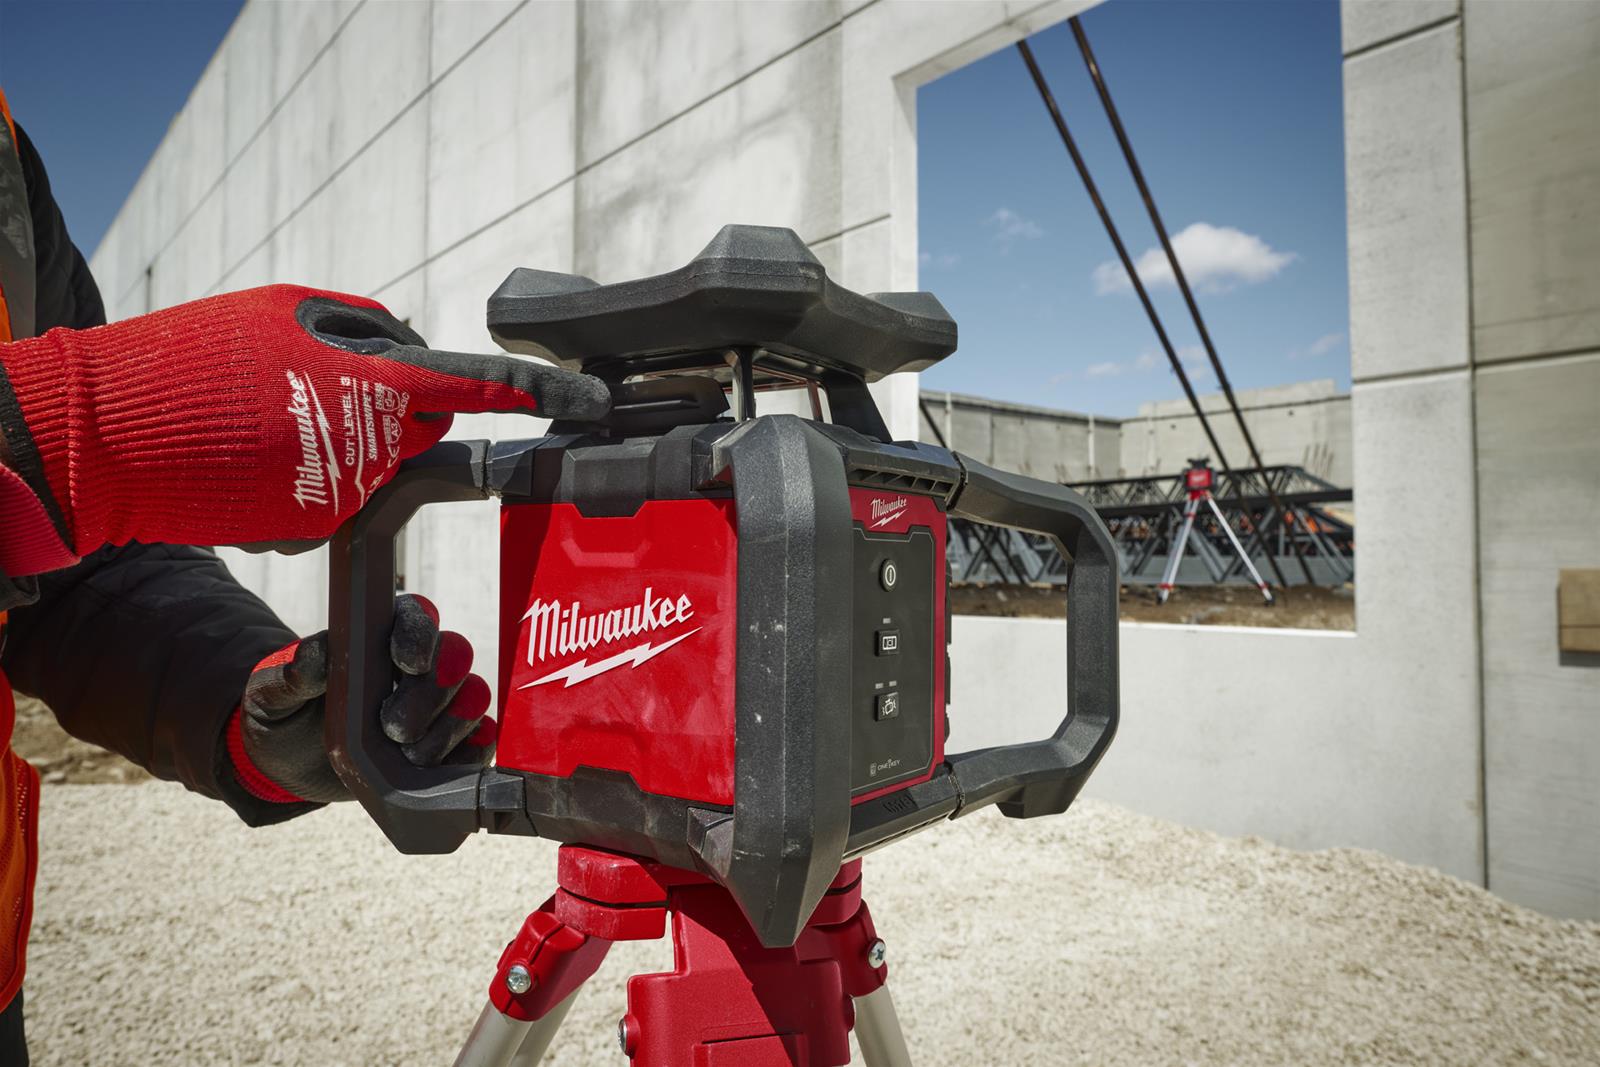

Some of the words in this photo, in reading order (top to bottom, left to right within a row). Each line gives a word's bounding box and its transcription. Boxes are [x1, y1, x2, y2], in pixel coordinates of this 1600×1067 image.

[343, 393, 354, 436] LEVEL
[391, 424, 399, 437] A3
[345, 439, 355, 466] CUT
[871, 496, 907, 520] Milwaukee
[518, 587, 695, 667] Milwaukee
